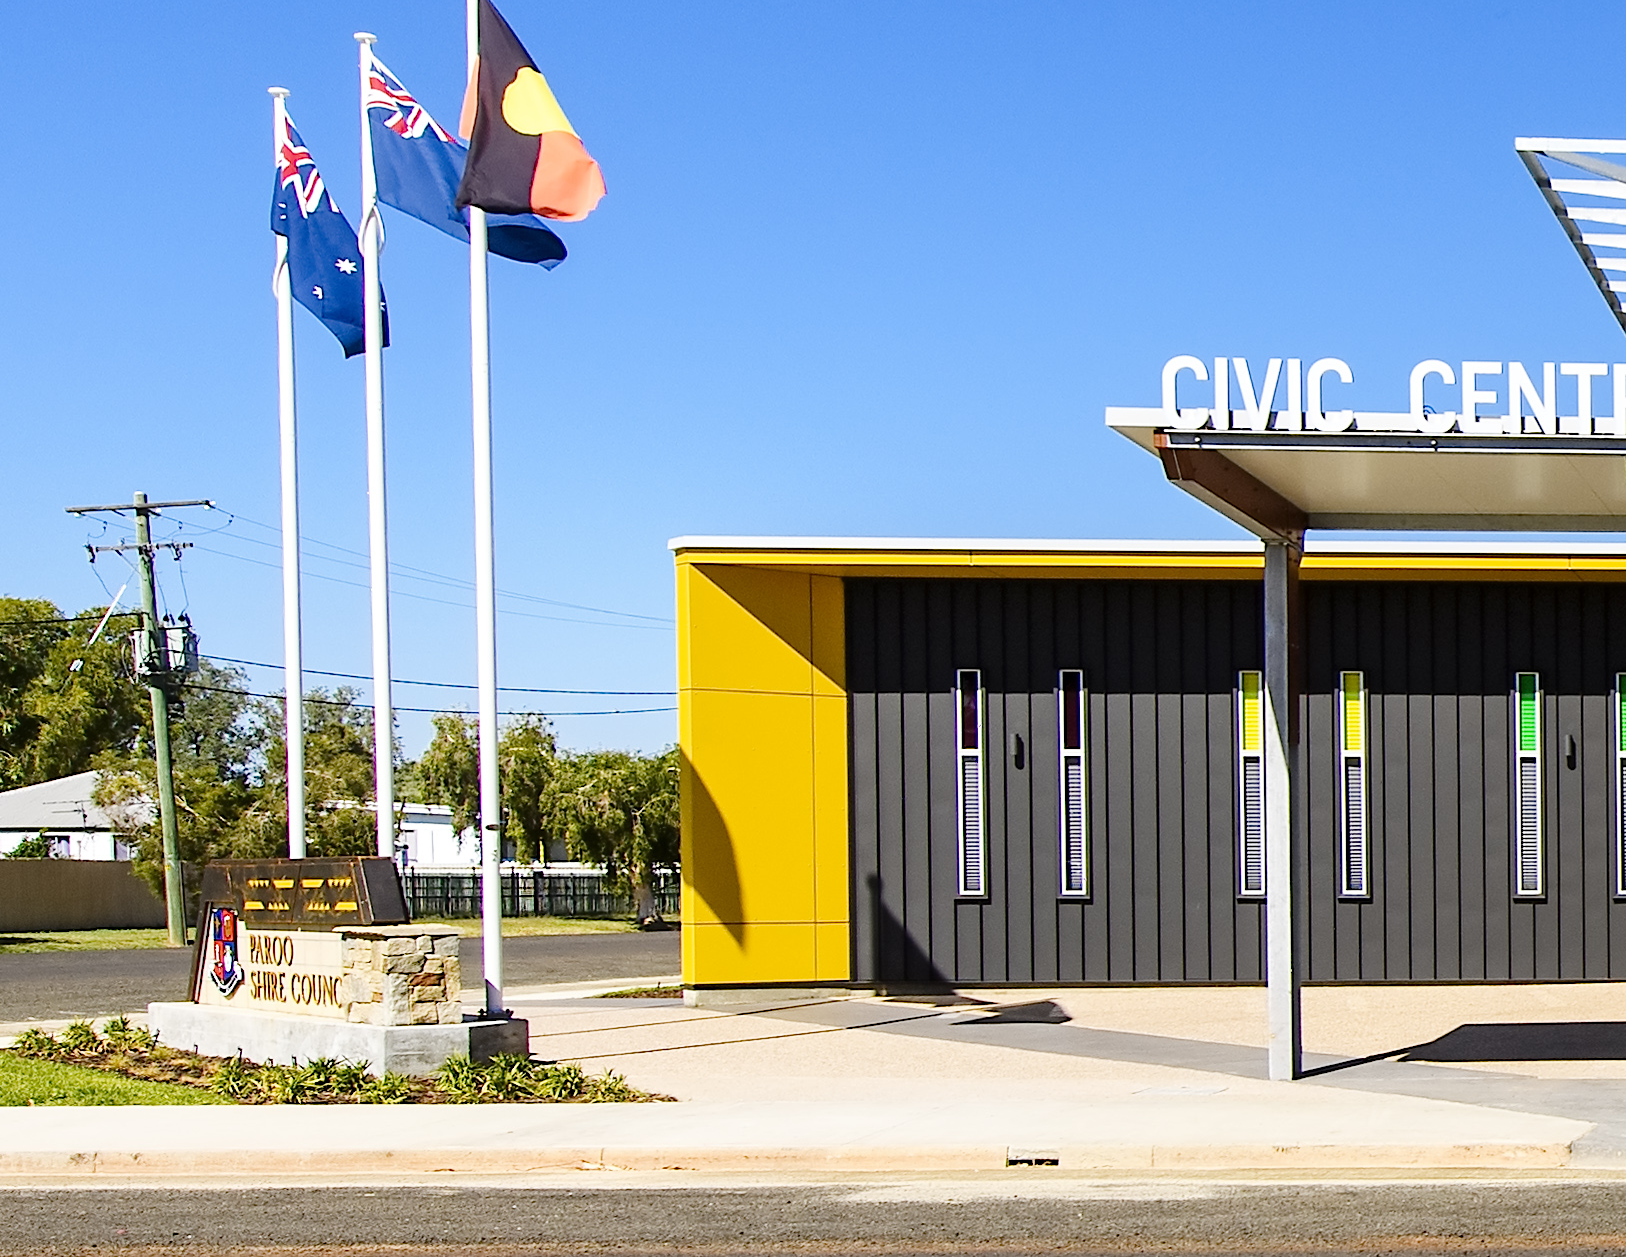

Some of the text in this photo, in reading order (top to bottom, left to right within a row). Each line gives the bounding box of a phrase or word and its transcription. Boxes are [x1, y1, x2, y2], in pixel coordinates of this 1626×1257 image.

[1161, 354, 1354, 432] CIVIC
[249, 934, 294, 966] PAROO
[250, 970, 287, 1003] SHIRE
